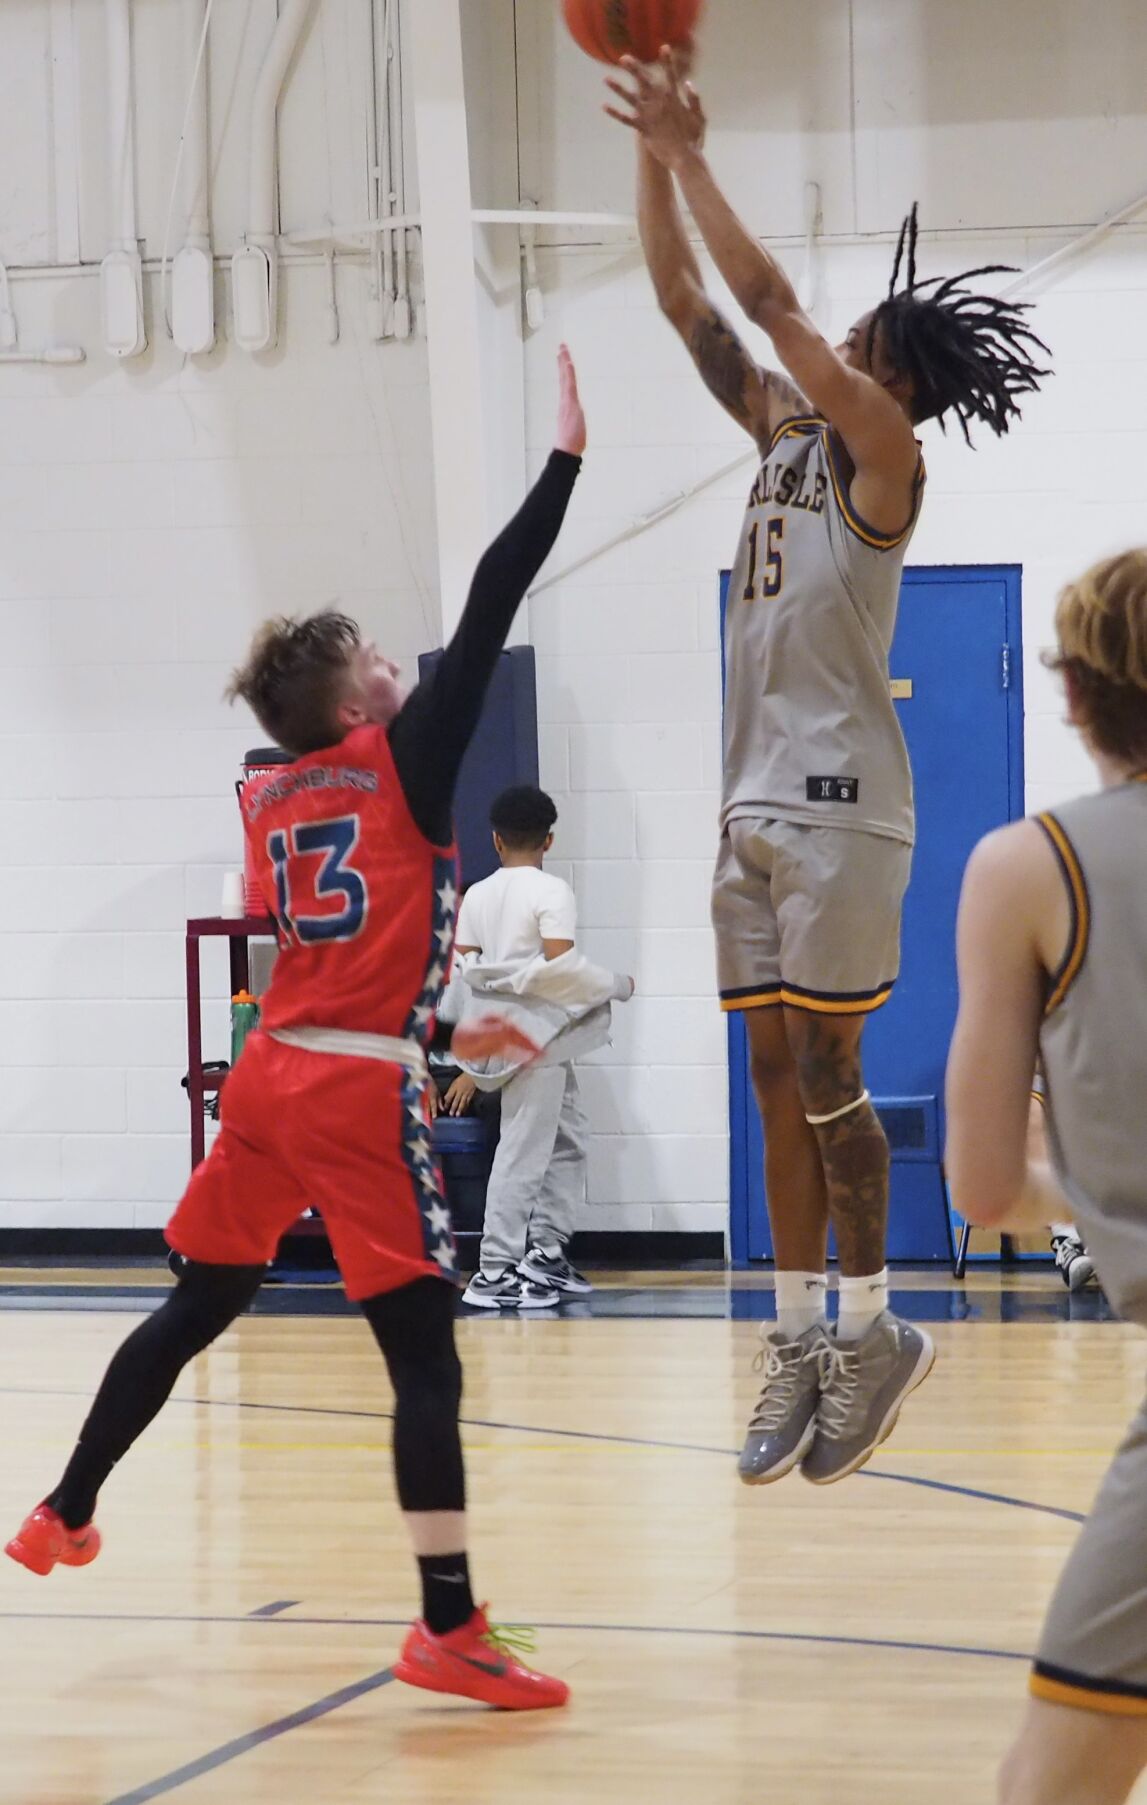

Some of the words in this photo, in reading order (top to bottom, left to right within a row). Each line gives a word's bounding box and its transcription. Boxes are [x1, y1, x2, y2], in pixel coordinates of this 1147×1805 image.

[742, 516, 785, 602] 15
[840, 786, 850, 799] S
[265, 812, 370, 949] 13
